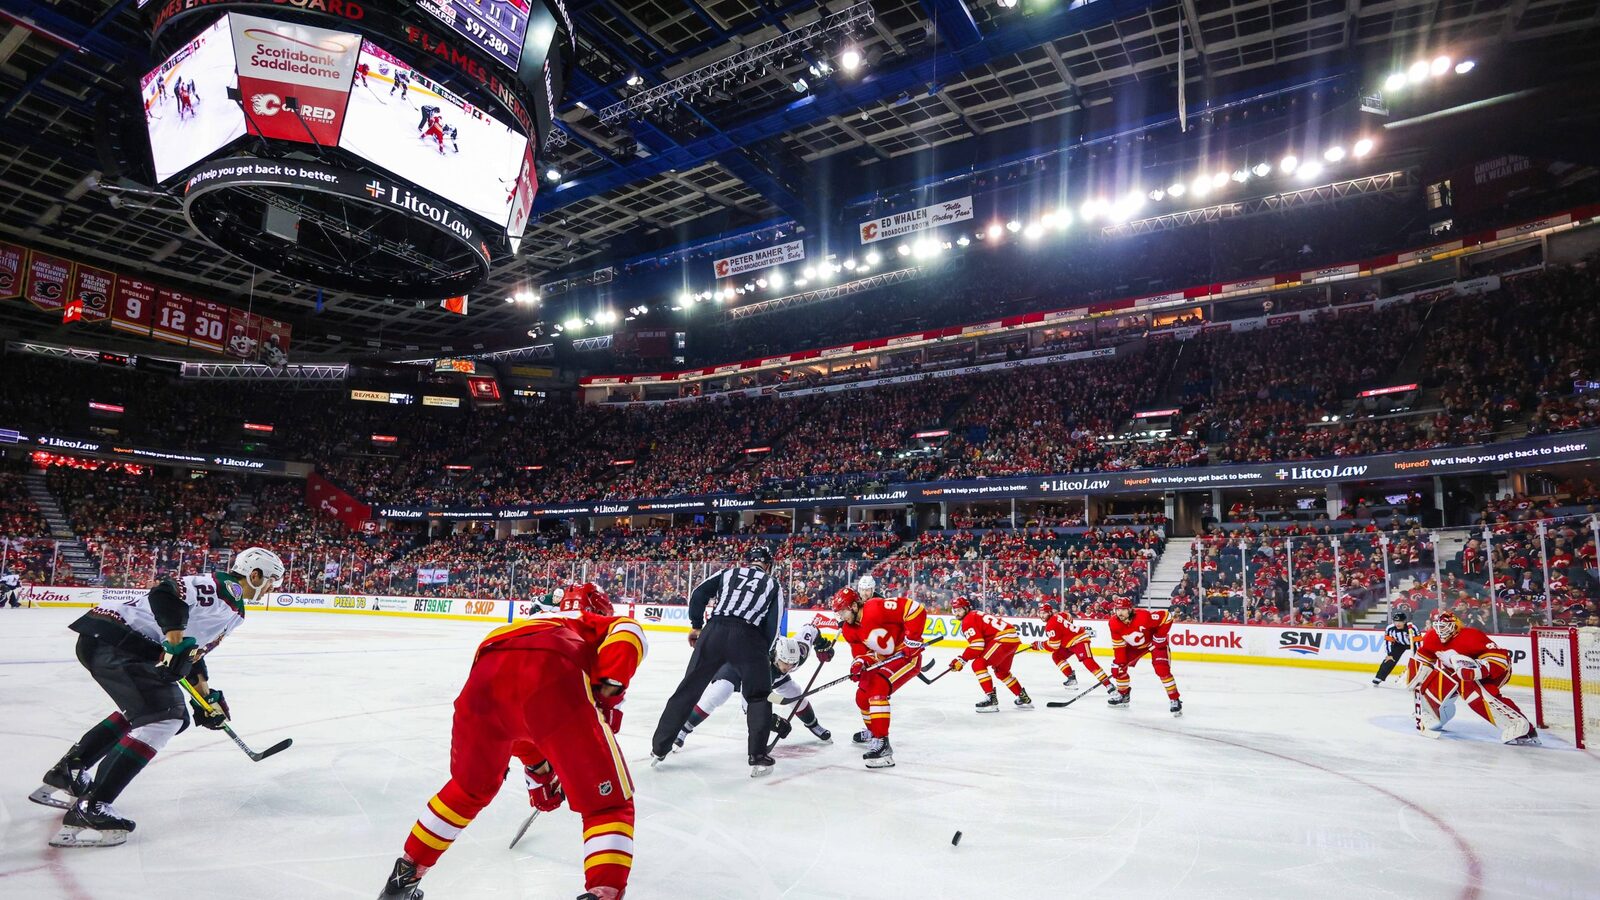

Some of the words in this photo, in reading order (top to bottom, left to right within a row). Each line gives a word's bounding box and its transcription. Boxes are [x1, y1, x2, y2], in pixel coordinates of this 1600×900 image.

[420, 0, 456, 26] JACKPOT
[490, 4, 501, 20] 11
[485, 14, 501, 27] SHOTS
[465, 17, 509, 56] $97,380
[256, 44, 335, 67] Scotiabank
[406, 26, 485, 84] FLAMES
[251, 55, 340, 79] Saddledome
[300, 104, 336, 120] RED
[202, 169, 218, 179] help
[218, 167, 235, 178] you
[236, 165, 253, 176] get
[255, 164, 282, 175] back
[284, 167, 298, 177] to
[299, 168, 340, 184] better.
[1475, 173, 1487, 185] WE
[1489, 167, 1511, 181] WEAR
[390, 186, 473, 240] LitcoLaw
[881, 218, 892, 228] ED
[894, 208, 927, 225] WHALEN
[932, 214, 953, 224] Hockey
[881, 225, 910, 238] BROADCAST
[912, 221, 930, 230] BOOTH
[1516, 220, 1550, 232] ICONIC
[0, 256, 17, 273] TERN
[730, 254, 754, 267] PETER
[755, 247, 783, 260] MAHER
[744, 259, 769, 270] BROADCAST
[769, 256, 784, 265] BOOTH
[32, 265, 70, 280] NORTHWEST
[36, 272, 64, 284] DIVISION
[81, 282, 107, 293] DIVISION
[83, 279, 106, 289] PACIFIC
[31, 295, 62, 307] CHAMPIONS
[125, 298, 142, 319] 9
[160, 307, 185, 331] 12
[194, 317, 224, 341] 30
[900, 372, 935, 382] PLATINM
[937, 369, 956, 377] CLUB
[49, 438, 99, 450] LitcoLaw
[223, 458, 264, 468] LitcoLaw
[1394, 459, 1430, 470] Injured?
[1431, 457, 1454, 466] We'll
[1455, 456, 1477, 465] help
[1478, 454, 1496, 463] you
[1497, 452, 1514, 461] get
[1514, 448, 1539, 458] back
[1540, 446, 1552, 455] to
[1553, 443, 1588, 454] better.
[1124, 478, 1150, 486] Injured?
[1168, 476, 1183, 484] help
[1211, 473, 1229, 481] back
[1292, 465, 1368, 480] LitcoLaw
[1052, 479, 1110, 491] LitcoLaw
[388, 509, 422, 518] LitcoLaw
[503, 510, 529, 518] LitcoLaw
[599, 505, 629, 513] LitcoLaw
[737, 575, 760, 591] 74
[197, 585, 215, 607] 22
[295, 596, 325, 606] Supreme
[334, 596, 356, 608] PIZZA
[356, 597, 367, 608] 73
[414, 599, 453, 612] BET99.NET
[472, 601, 495, 615] SKIP
[644, 607, 664, 618] SN
[1013, 622, 1047, 637] etw
[1171, 629, 1243, 649] abank
[1279, 631, 1322, 651] SN
